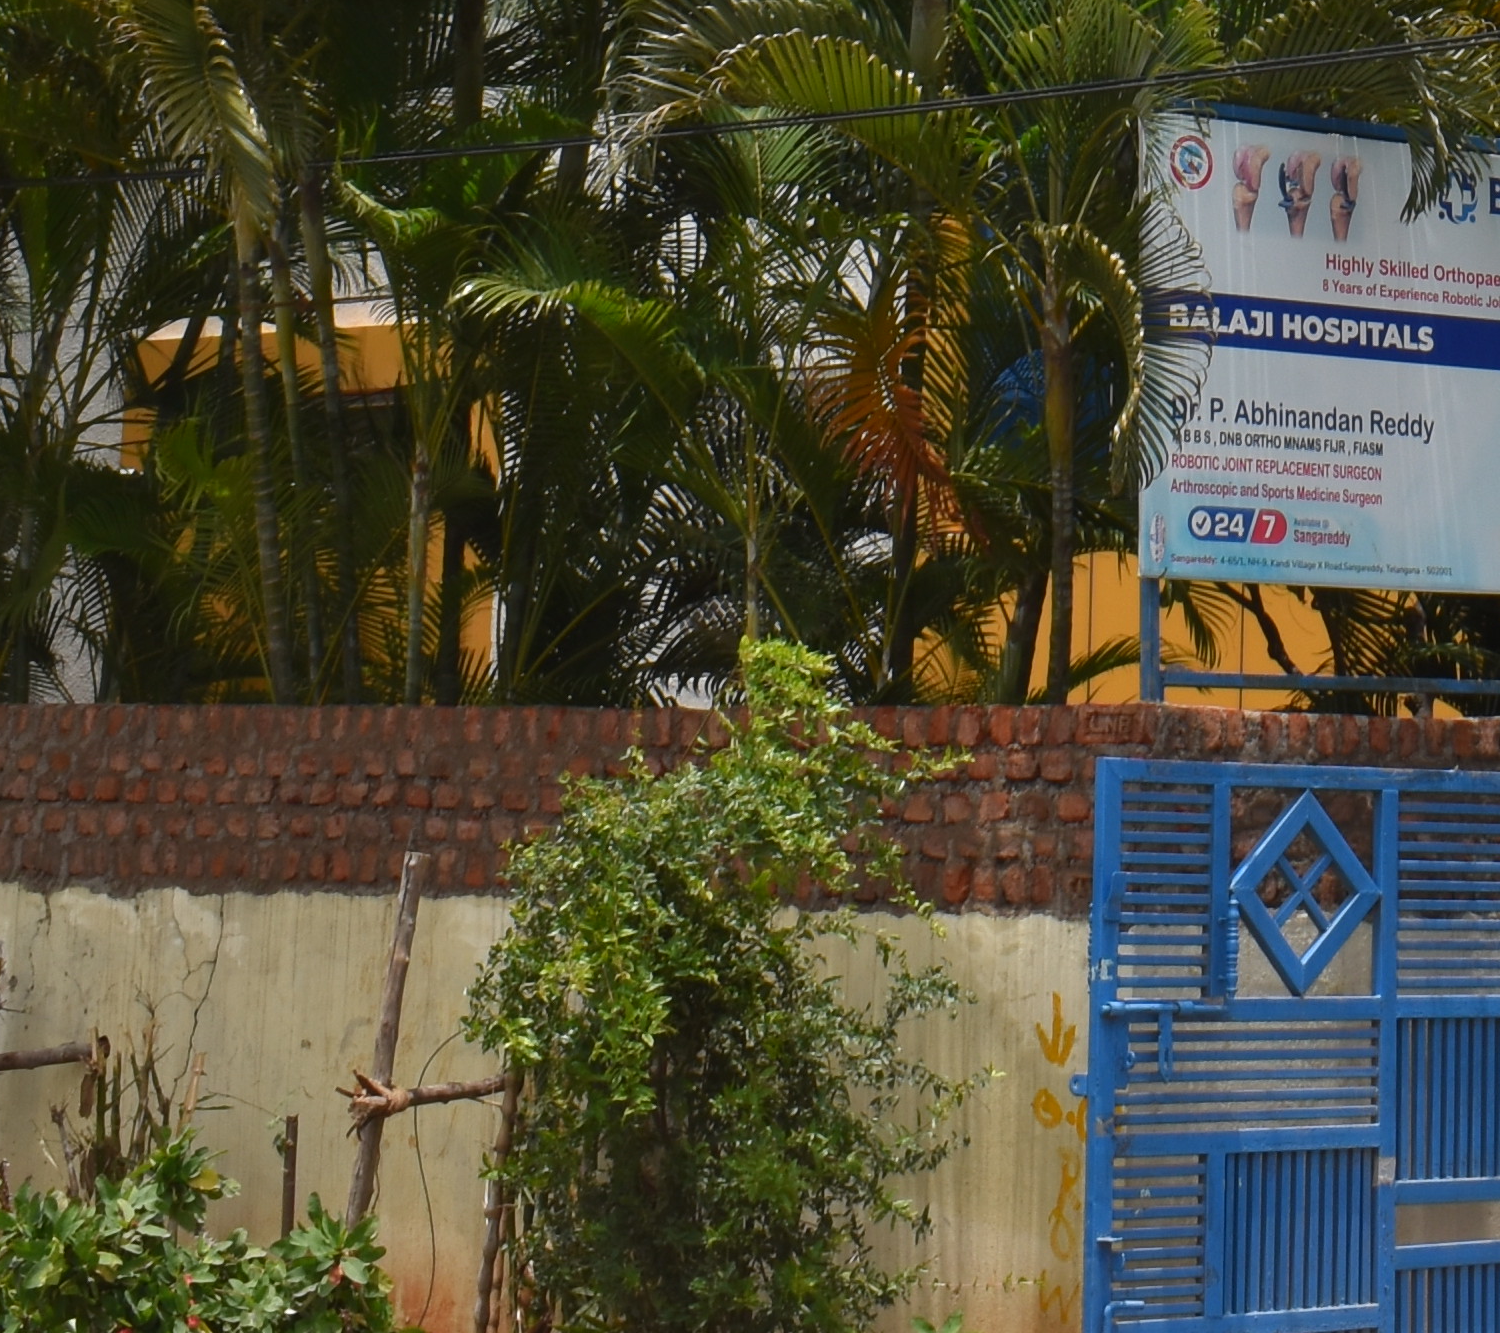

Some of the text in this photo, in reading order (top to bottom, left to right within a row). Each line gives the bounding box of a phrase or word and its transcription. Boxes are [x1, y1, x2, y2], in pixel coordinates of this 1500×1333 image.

[1325, 253, 1374, 278] Highly
[1379, 259, 1429, 280] Skilled
[1322, 279, 1329, 292] 8
[1332, 280, 1363, 295] Years
[1366, 283, 1377, 297] of
[1380, 285, 1439, 306] Experience
[1442, 291, 1483, 308] Robotic
[1170, 304, 1435, 352] BALAJI HOSPITALS
[1210, 397, 1227, 423] P.
[1234, 399, 1363, 434] Abhinandan
[1370, 410, 1435, 444] Reddy
[1220, 431, 1242, 446] DNB
[1245, 433, 1282, 449] ORTHO
[1284, 435, 1322, 453] MNAMS
[1353, 441, 1384, 456] FIASM
[1171, 453, 1382, 481] ROBOTIC JOINT REPLACEMENT SURGEON
[1171, 478, 1383, 508] Arthroscopic and Sports Medicine Surgeon
[1214, 513, 1276, 539] 24 7
[1293, 529, 1351, 548] Sangareddy
[1170, 553, 1218, 566] Sangareddy:
